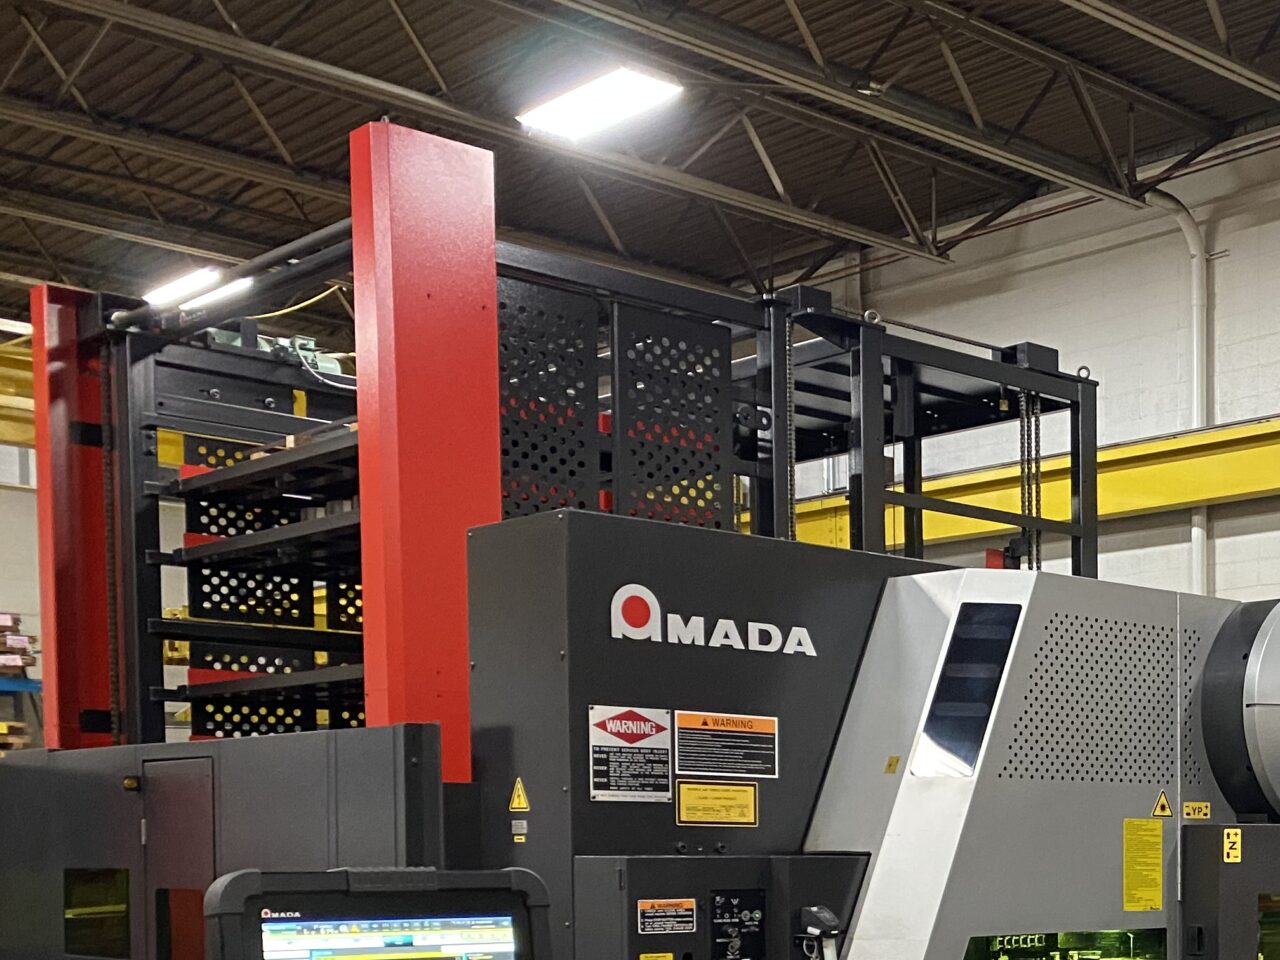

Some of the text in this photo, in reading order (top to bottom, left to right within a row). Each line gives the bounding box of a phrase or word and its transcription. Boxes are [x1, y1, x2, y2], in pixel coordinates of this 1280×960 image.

[610, 583, 817, 657] AMADA
[605, 719, 656, 735] WARNING
[711, 718, 753, 730] WARNING
[1192, 806, 1202, 816] YP
[1229, 842, 1237, 850] Z
[261, 908, 301, 919] AMADA
